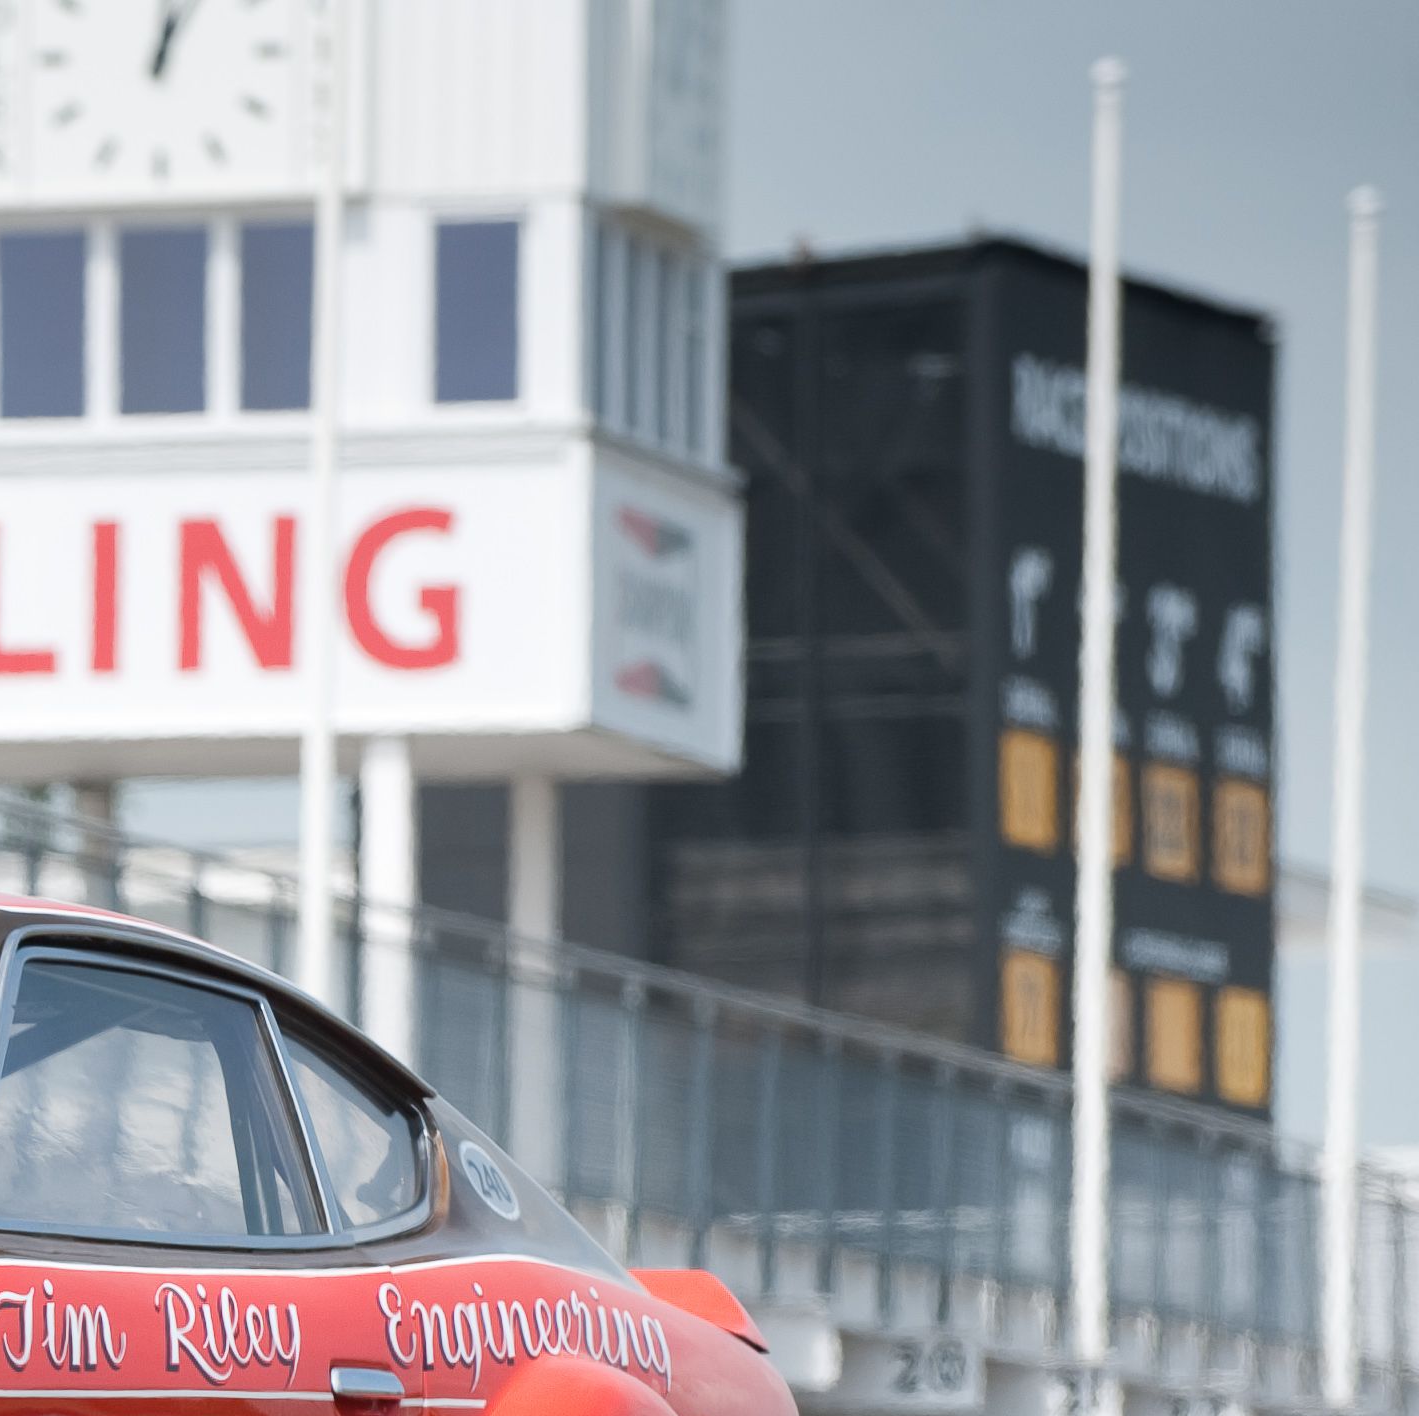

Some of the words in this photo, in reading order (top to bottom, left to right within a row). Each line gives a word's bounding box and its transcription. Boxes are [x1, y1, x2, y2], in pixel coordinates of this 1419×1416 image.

[466, 1159, 512, 1203] 240
[154, 1282, 301, 1389] Riley
[378, 1282, 672, 1394] Engineering
